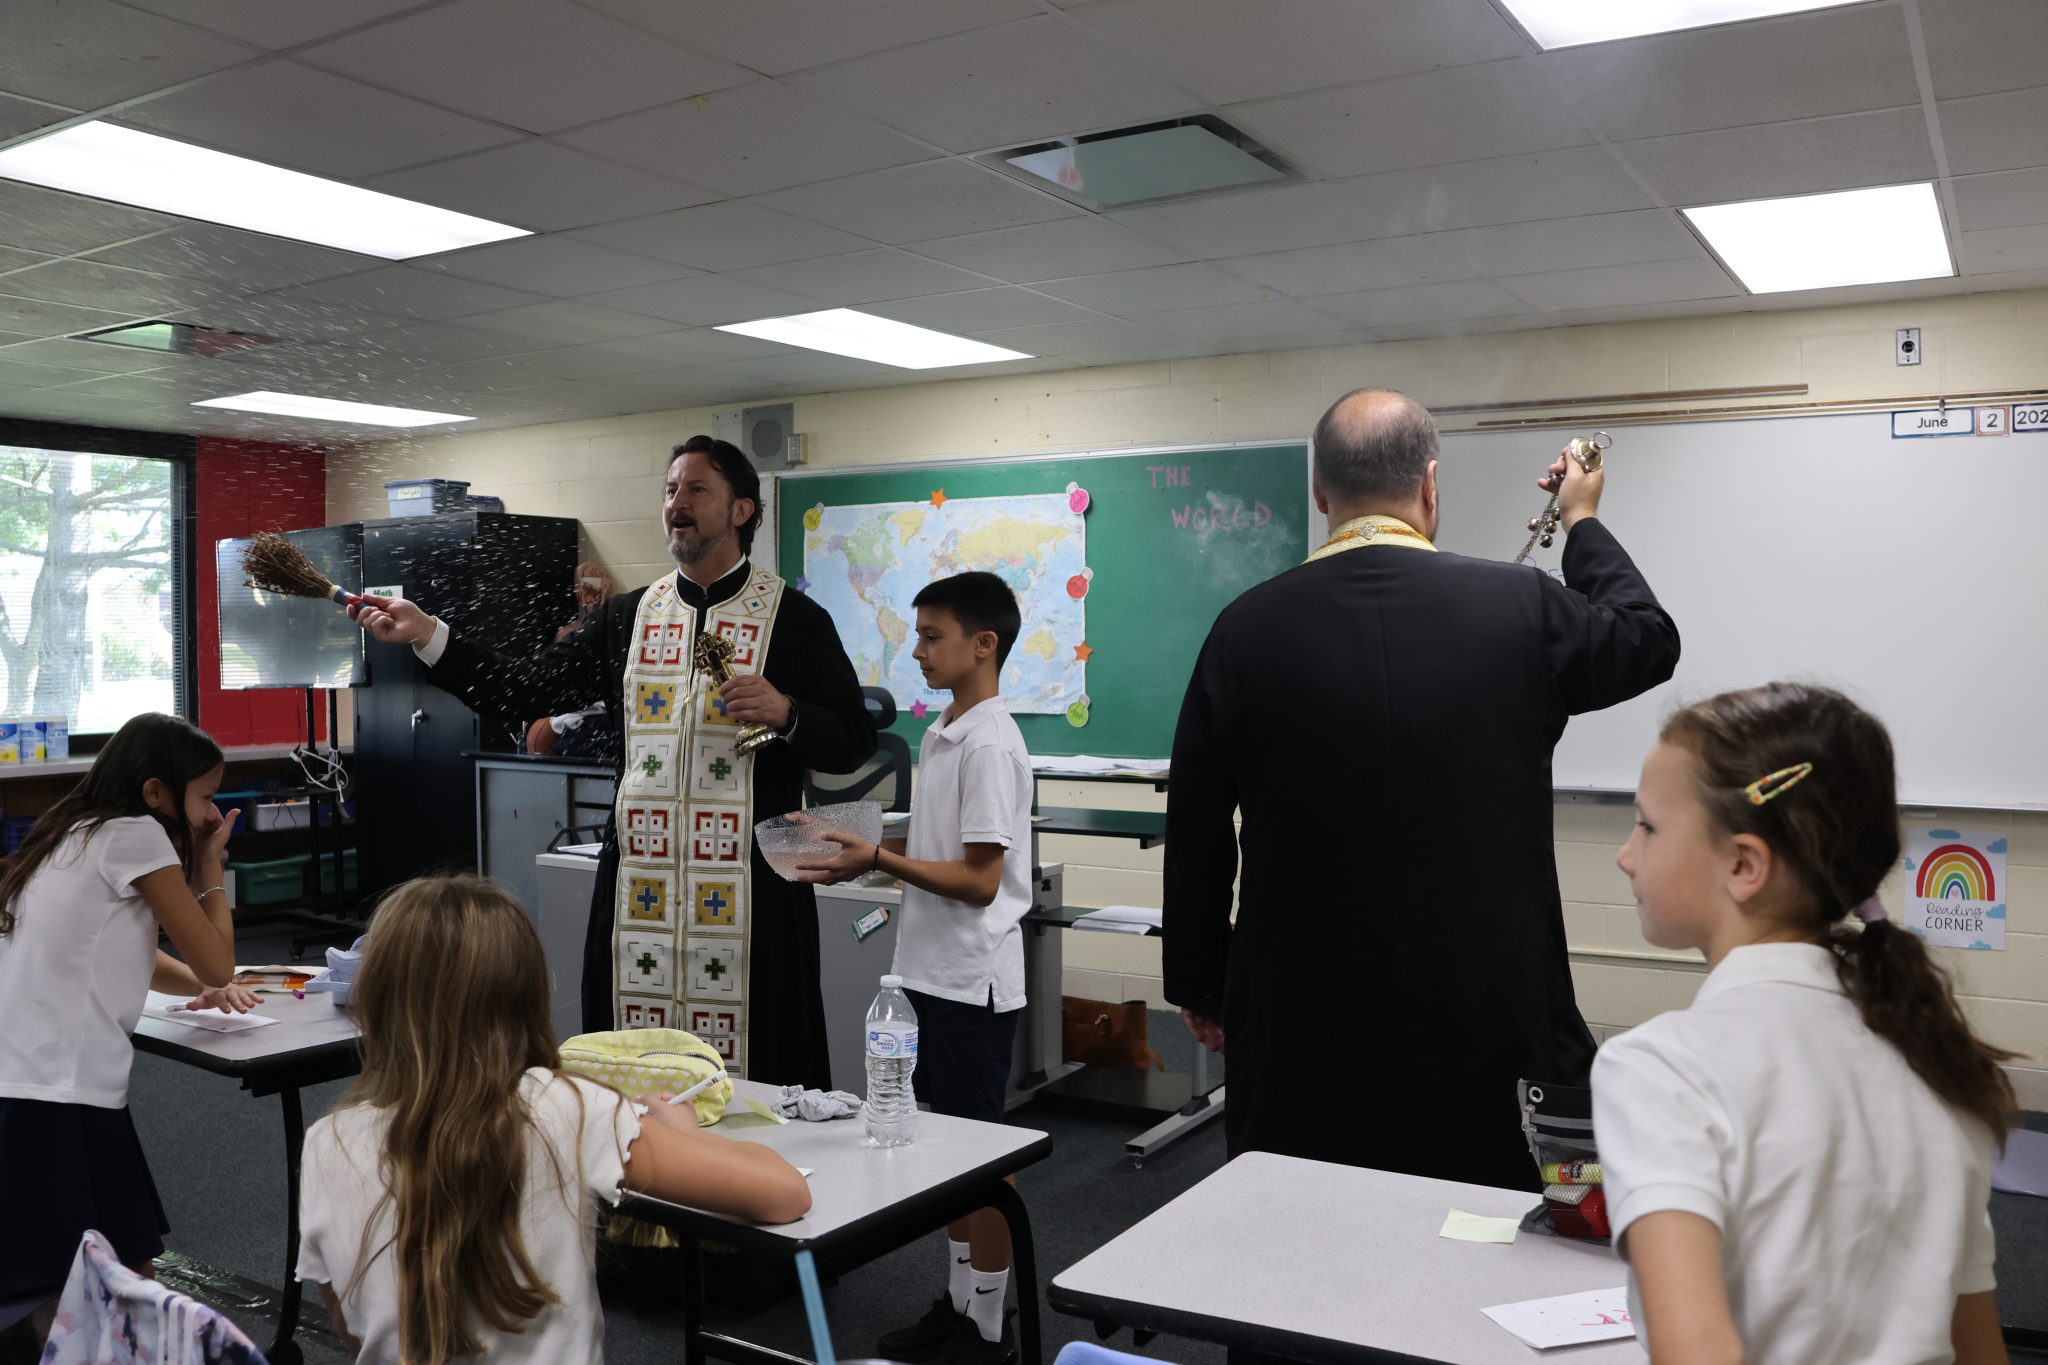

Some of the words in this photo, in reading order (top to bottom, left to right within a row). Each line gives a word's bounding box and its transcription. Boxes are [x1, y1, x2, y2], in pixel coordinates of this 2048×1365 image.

[1917, 417, 1948, 428] June
[1986, 413, 1998, 428] 2
[2016, 409, 2048, 425] 202
[1145, 466, 1192, 488] THE
[1171, 501, 1273, 532] WORLD
[1926, 902, 1984, 919] Reading
[1925, 917, 1984, 932] CORNER
